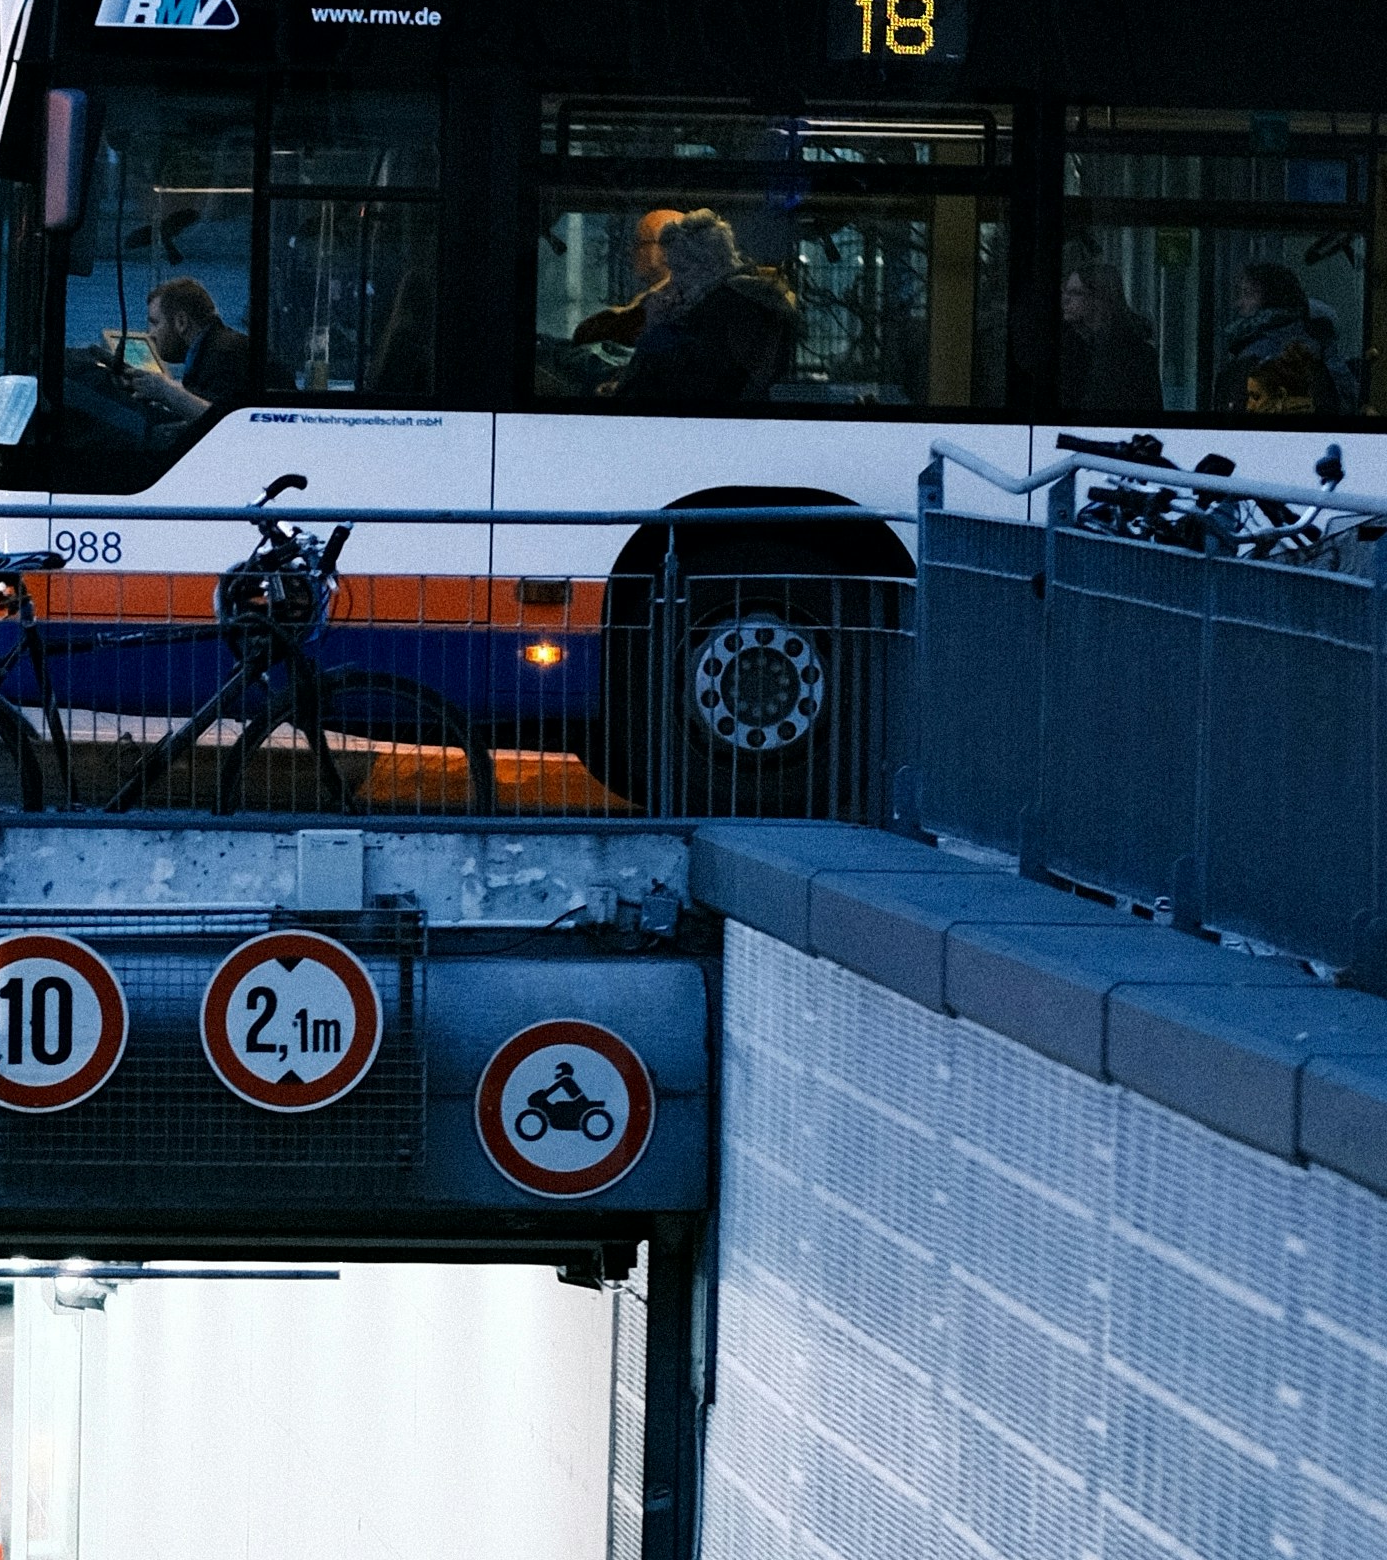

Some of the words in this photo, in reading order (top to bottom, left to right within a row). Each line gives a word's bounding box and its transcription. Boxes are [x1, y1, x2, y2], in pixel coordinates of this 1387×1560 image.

[311, 6, 442, 26] www.rmv.de
[249, 413, 299, 423] ESWE
[300, 414, 413, 427] Verkehrsgesellschaft
[416, 416, 443, 427] mbH
[55, 530, 123, 565] 988
[245, 985, 342, 1064] 2,1m
